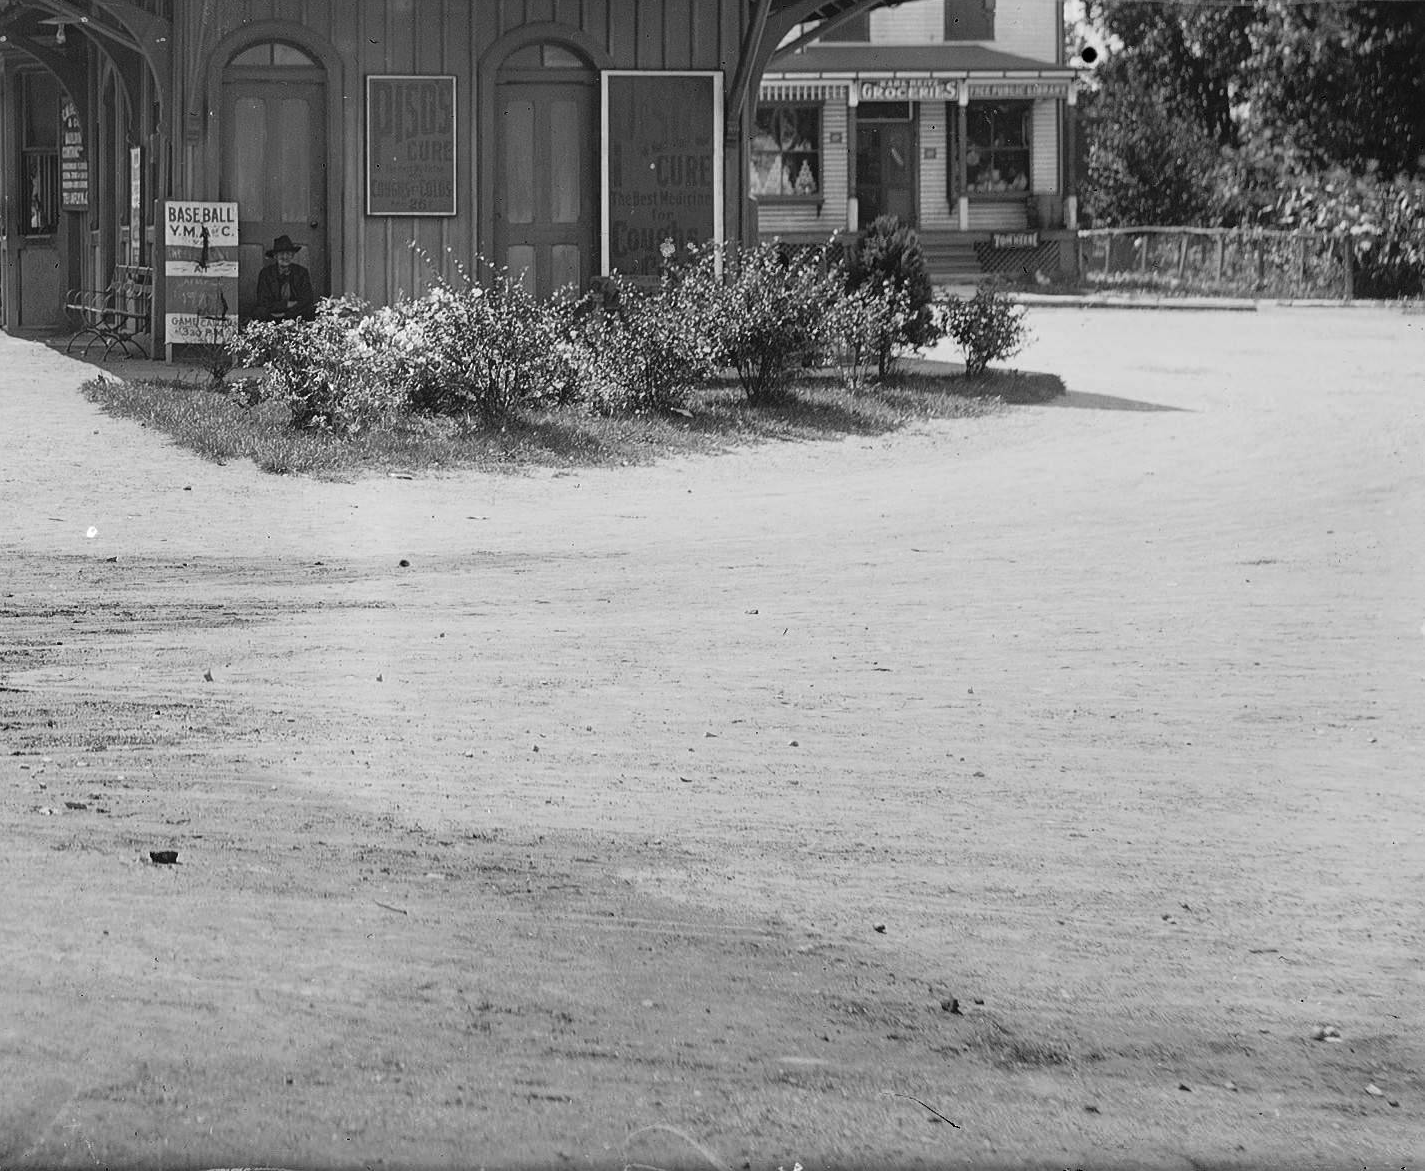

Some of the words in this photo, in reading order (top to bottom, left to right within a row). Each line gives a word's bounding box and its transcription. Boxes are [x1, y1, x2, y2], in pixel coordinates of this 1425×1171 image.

[861, 81, 957, 100] GROCERIES
[406, 140, 453, 163] CURE
[655, 155, 712, 188] CURE
[651, 209, 674, 223] for
[171, 316, 198, 327] GAME
